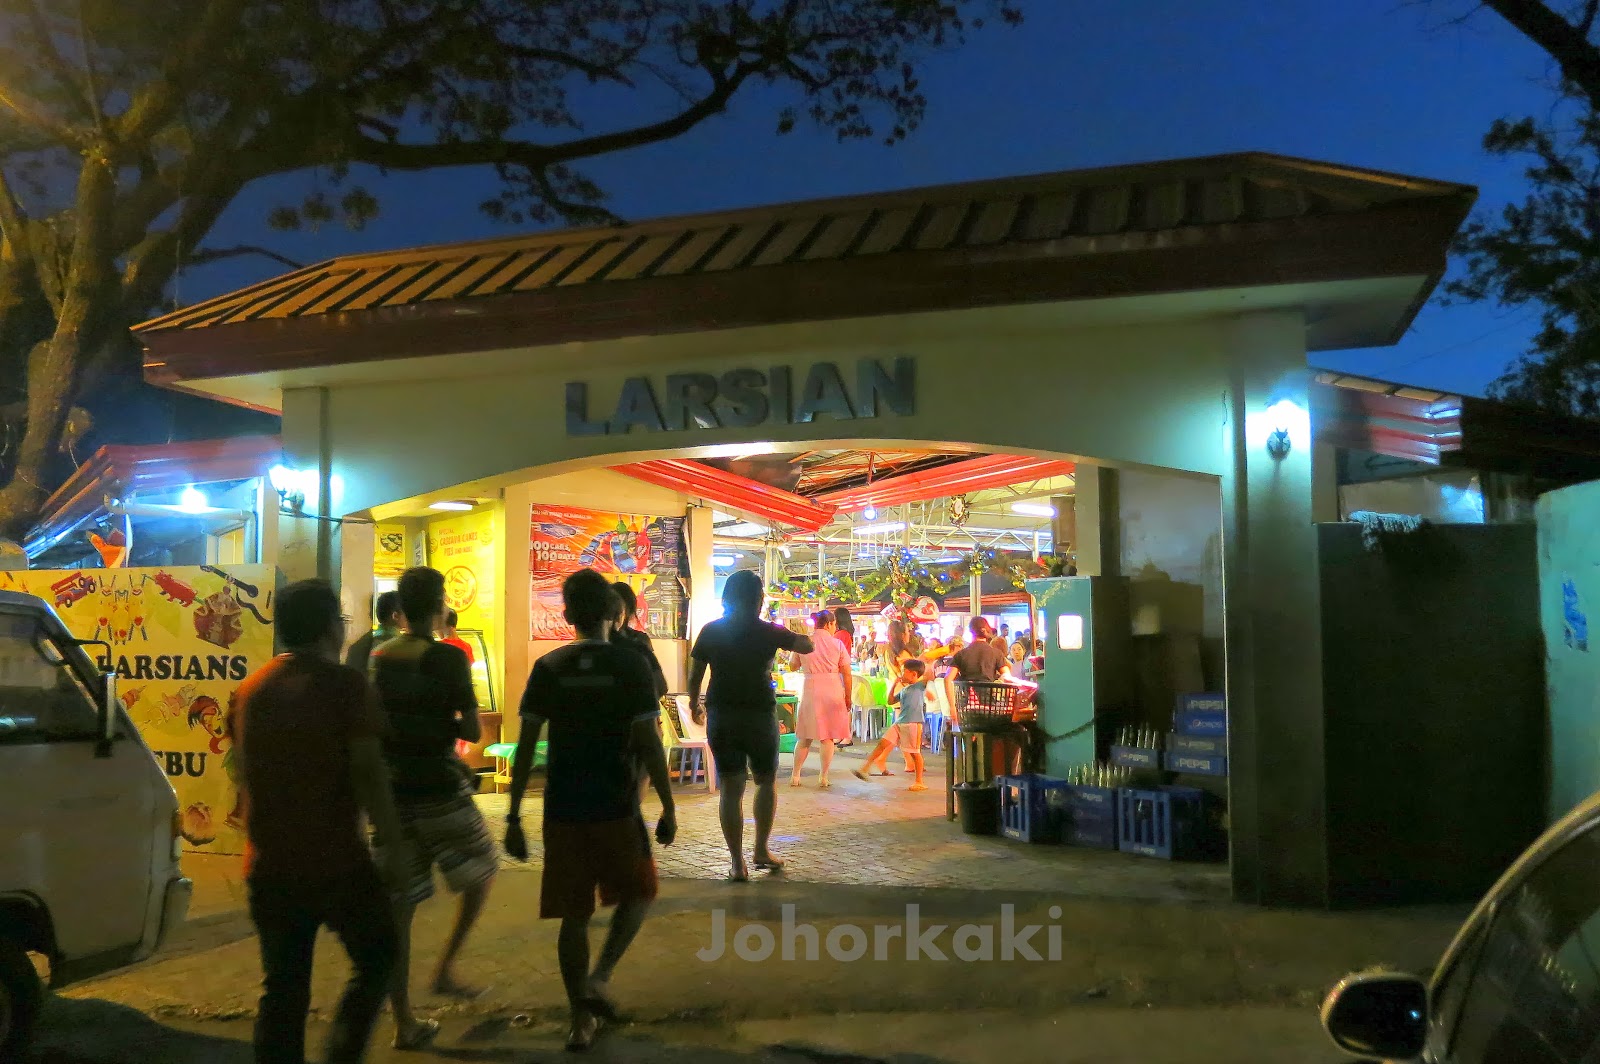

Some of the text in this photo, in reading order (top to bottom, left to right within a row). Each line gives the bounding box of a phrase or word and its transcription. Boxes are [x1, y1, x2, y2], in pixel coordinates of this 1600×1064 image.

[565, 356, 916, 437] LARSIAN
[536, 550, 558, 561] 100
[153, 750, 208, 778] BU
[1179, 757, 1210, 770] PEPSI
